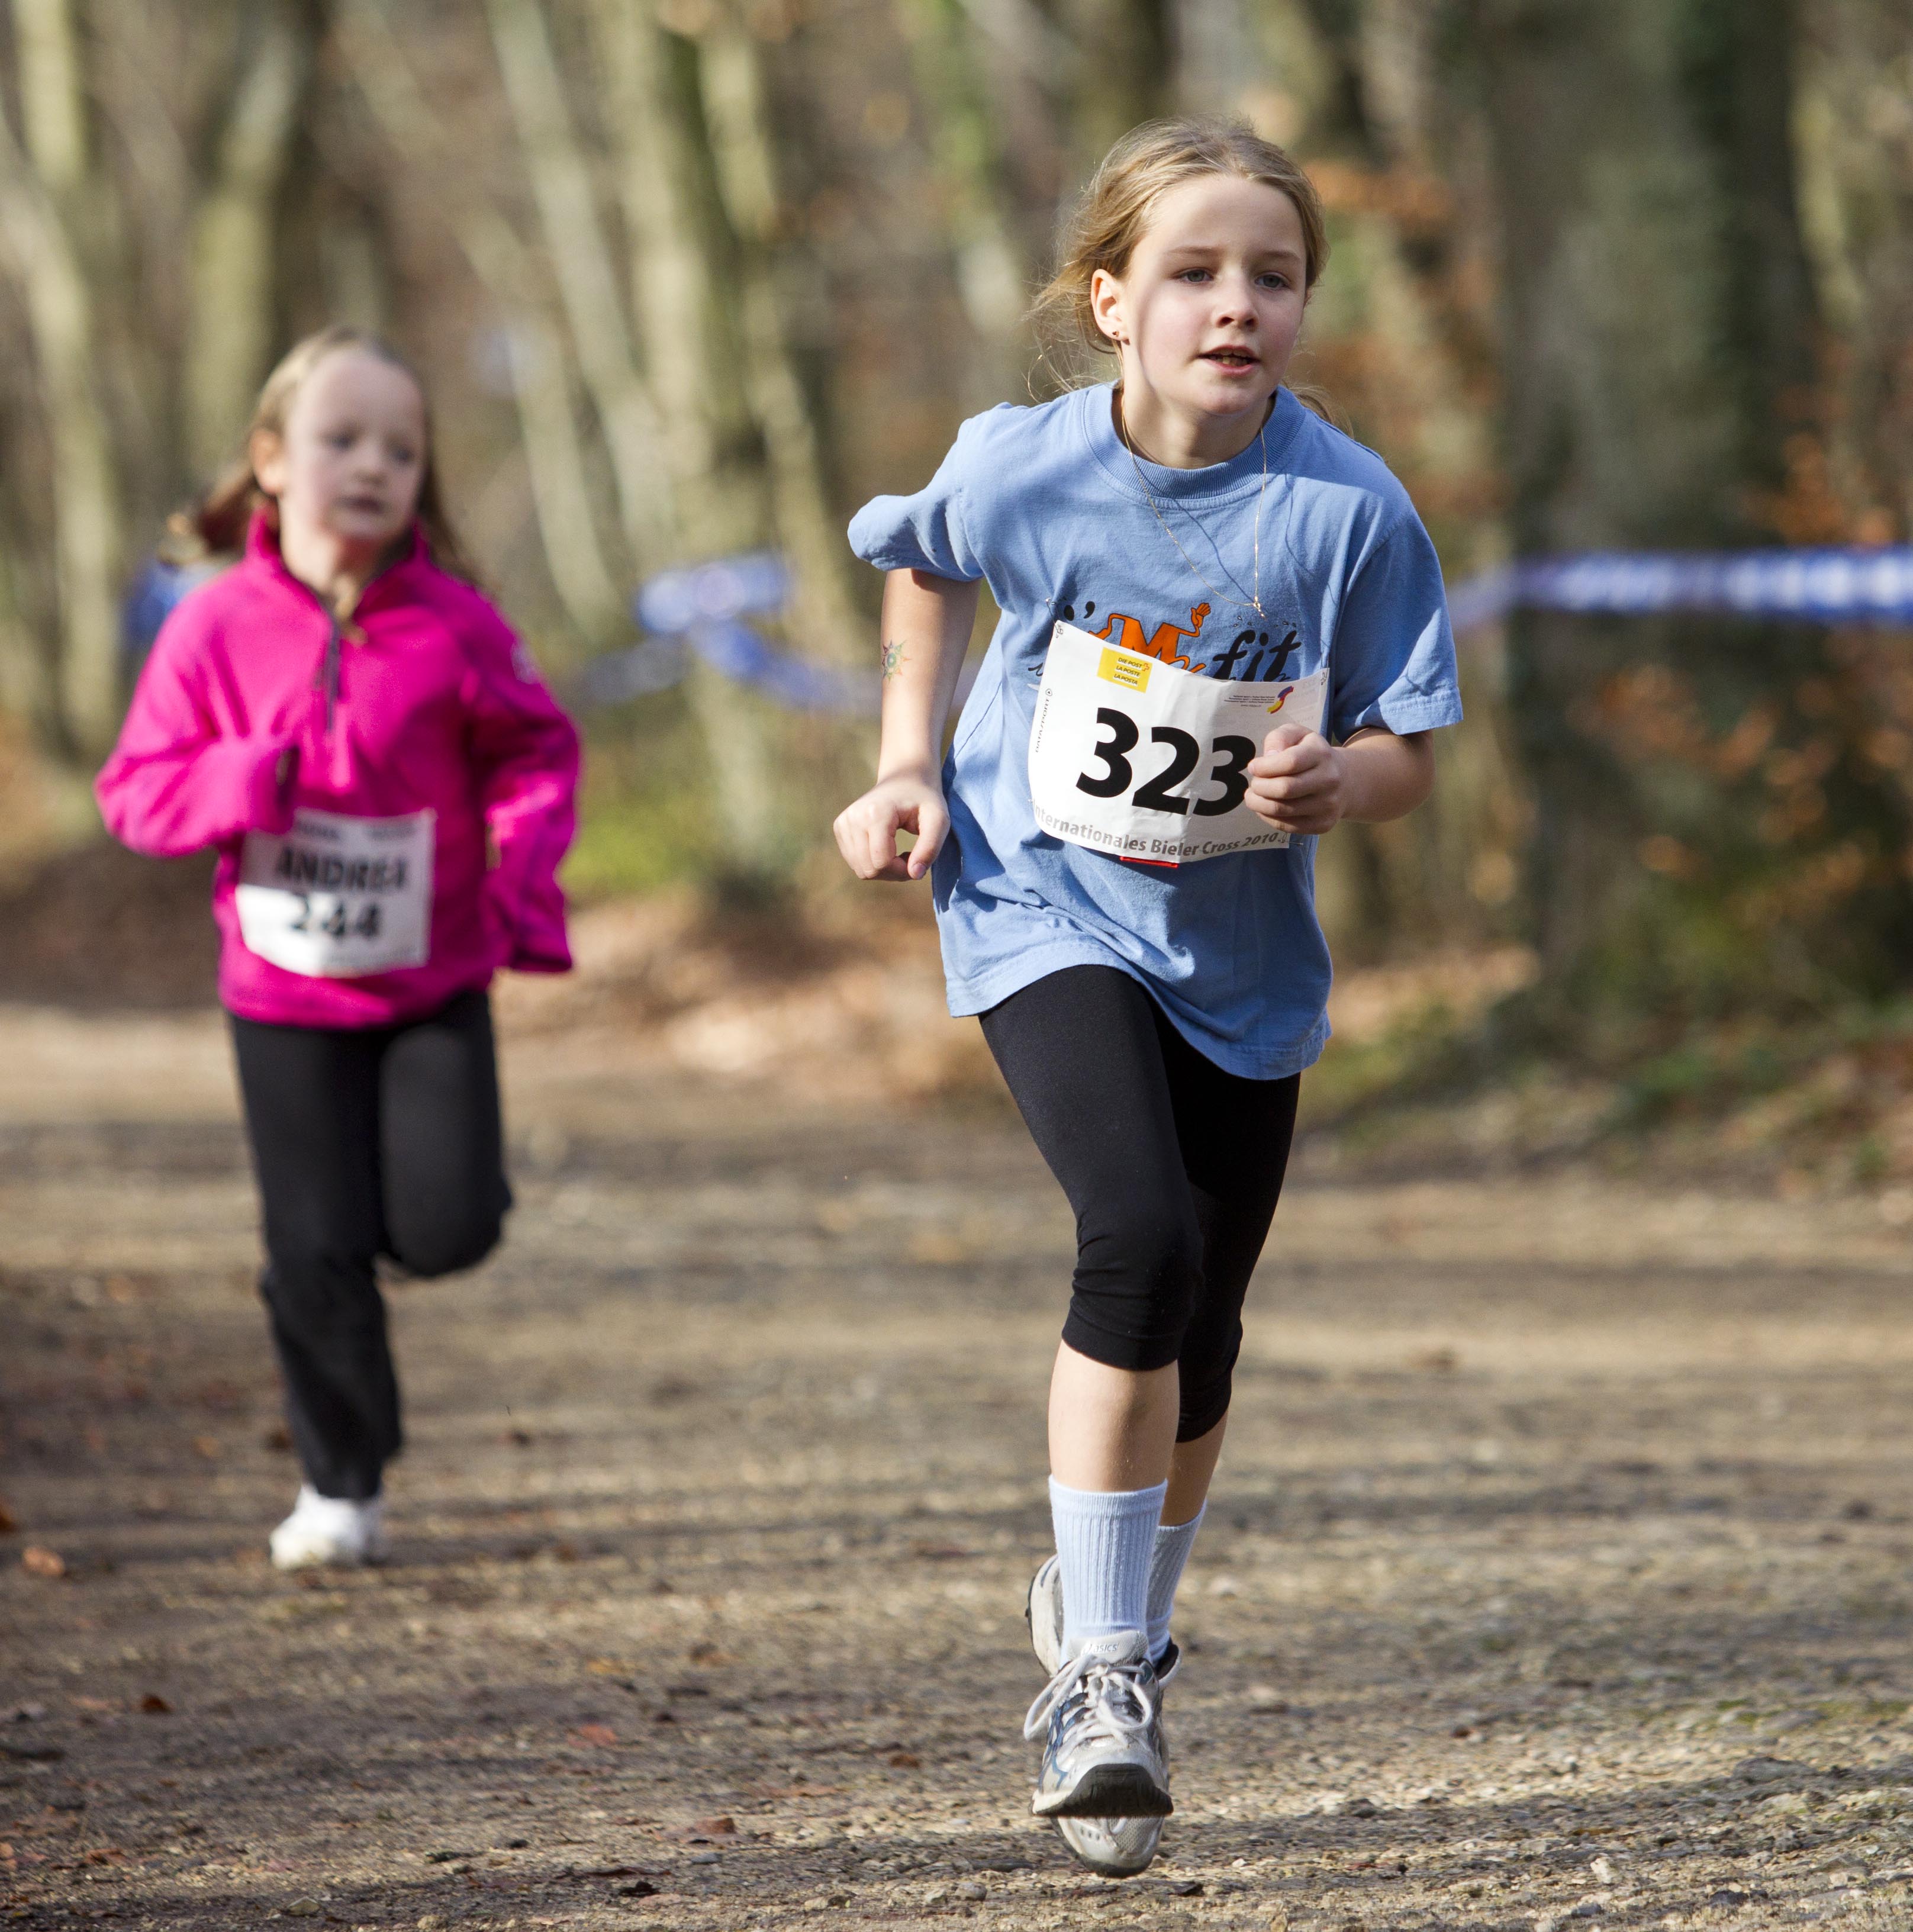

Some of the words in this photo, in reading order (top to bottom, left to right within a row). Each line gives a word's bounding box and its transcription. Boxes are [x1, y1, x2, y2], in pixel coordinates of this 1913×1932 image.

[1213, 630, 1301, 682] fit
[1121, 676, 1138, 684] POSTA
[1123, 668, 1141, 677] POSTE
[1075, 707, 1256, 816] 323
[1151, 839, 1199, 856] Bieler
[1203, 841, 1240, 855] Cross
[1242, 832, 1278, 848] 2010
